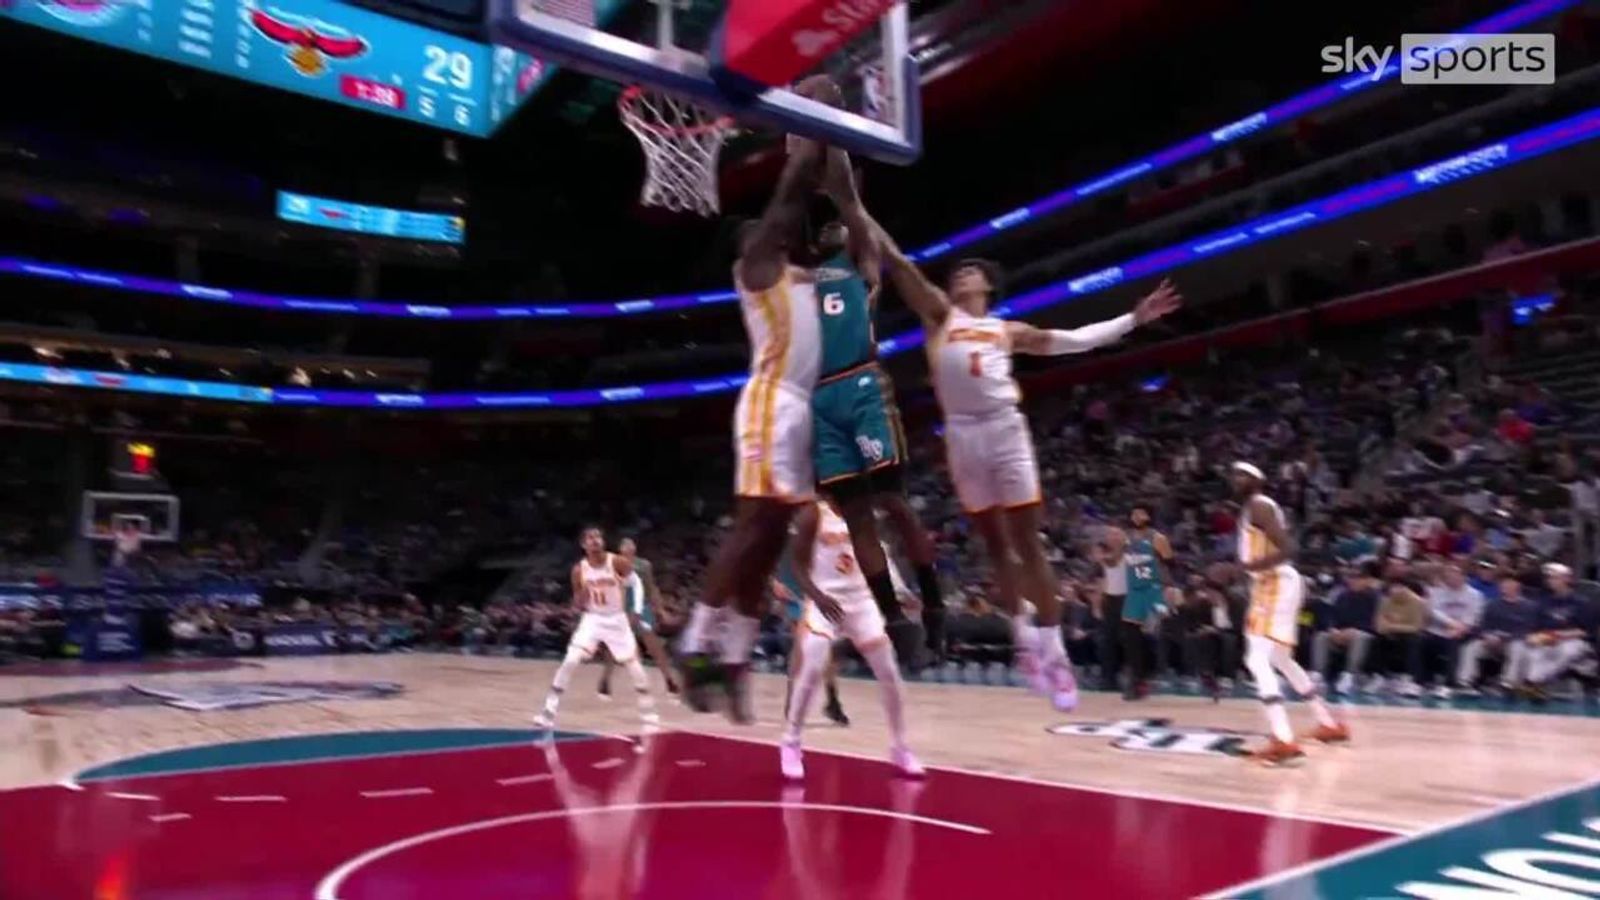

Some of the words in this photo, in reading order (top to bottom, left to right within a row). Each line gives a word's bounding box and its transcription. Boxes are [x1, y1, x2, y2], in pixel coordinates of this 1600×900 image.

[421, 43, 472, 90] 29
[824, 292, 845, 316] 6
[969, 350, 983, 378] 1
[593, 589, 607, 606] 11
